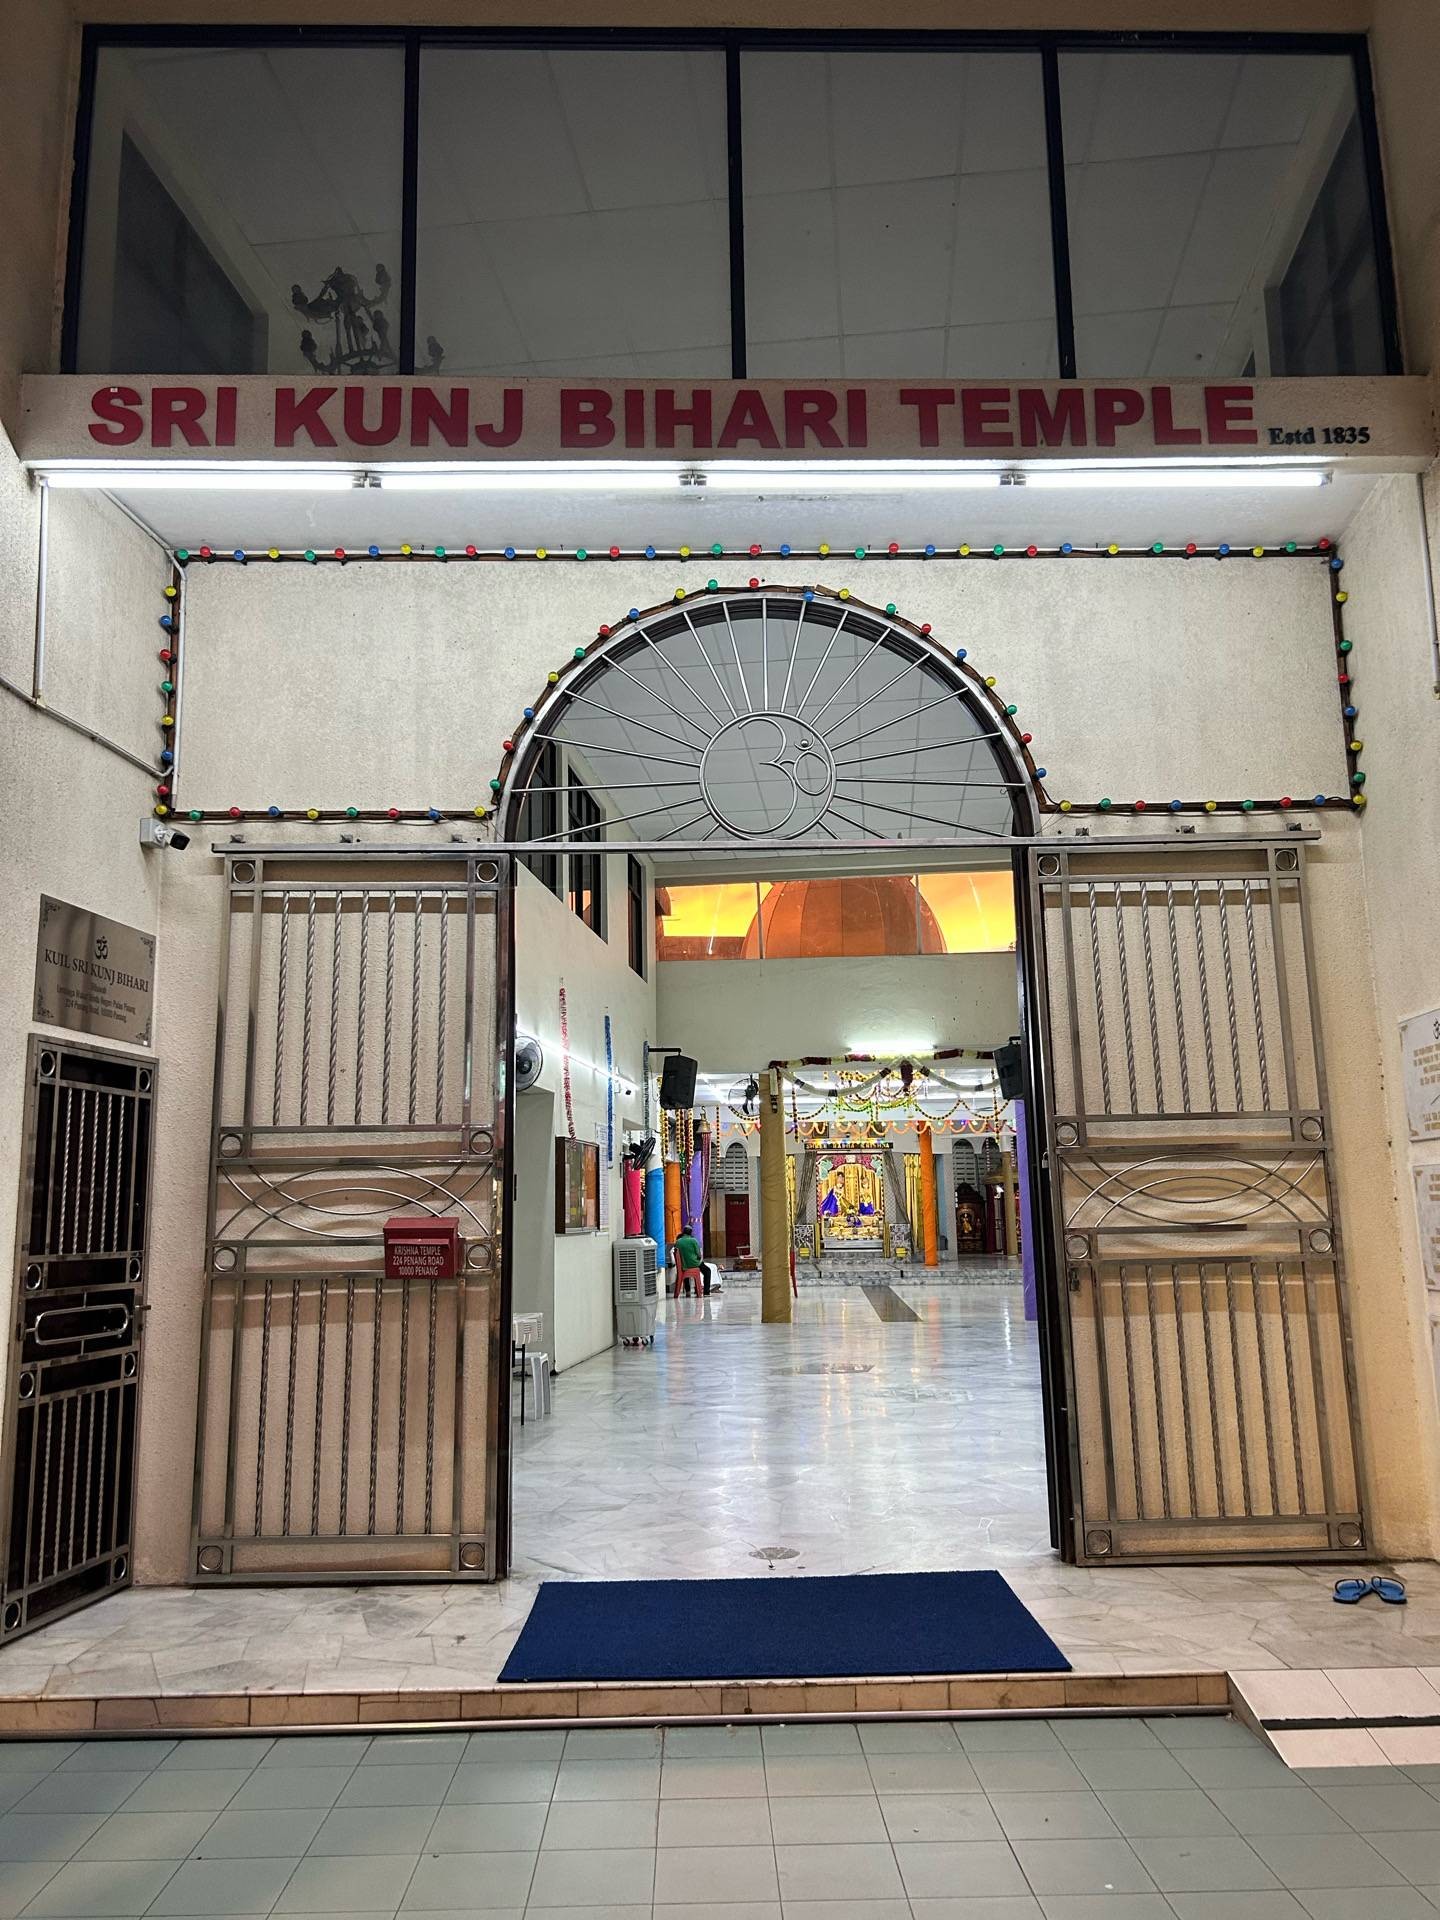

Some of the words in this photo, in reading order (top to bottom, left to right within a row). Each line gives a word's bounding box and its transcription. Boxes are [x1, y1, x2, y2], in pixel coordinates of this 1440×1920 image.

[88, 387, 237, 447] SRI
[274, 387, 523, 447] KUNJ
[560, 389, 867, 449] BIHARI
[901, 386, 1259, 448] TEMPLE
[1268, 427, 1316, 445] Estd
[1322, 427, 1370, 444] 1835
[44, 948, 70, 969] KUIL
[72, 958, 88, 975] SRI
[90, 962, 116, 986] KUNJ
[117, 974, 149, 992] BIHARI
[394, 1245, 419, 1255] KRISHNA
[420, 1245, 441, 1255] TEMPLE
[393, 1256, 403, 1265] 224
[404, 1256, 427, 1266] PENANG
[428, 1256, 444, 1265] ROAD
[415, 1266, 438, 1275] PENANG
